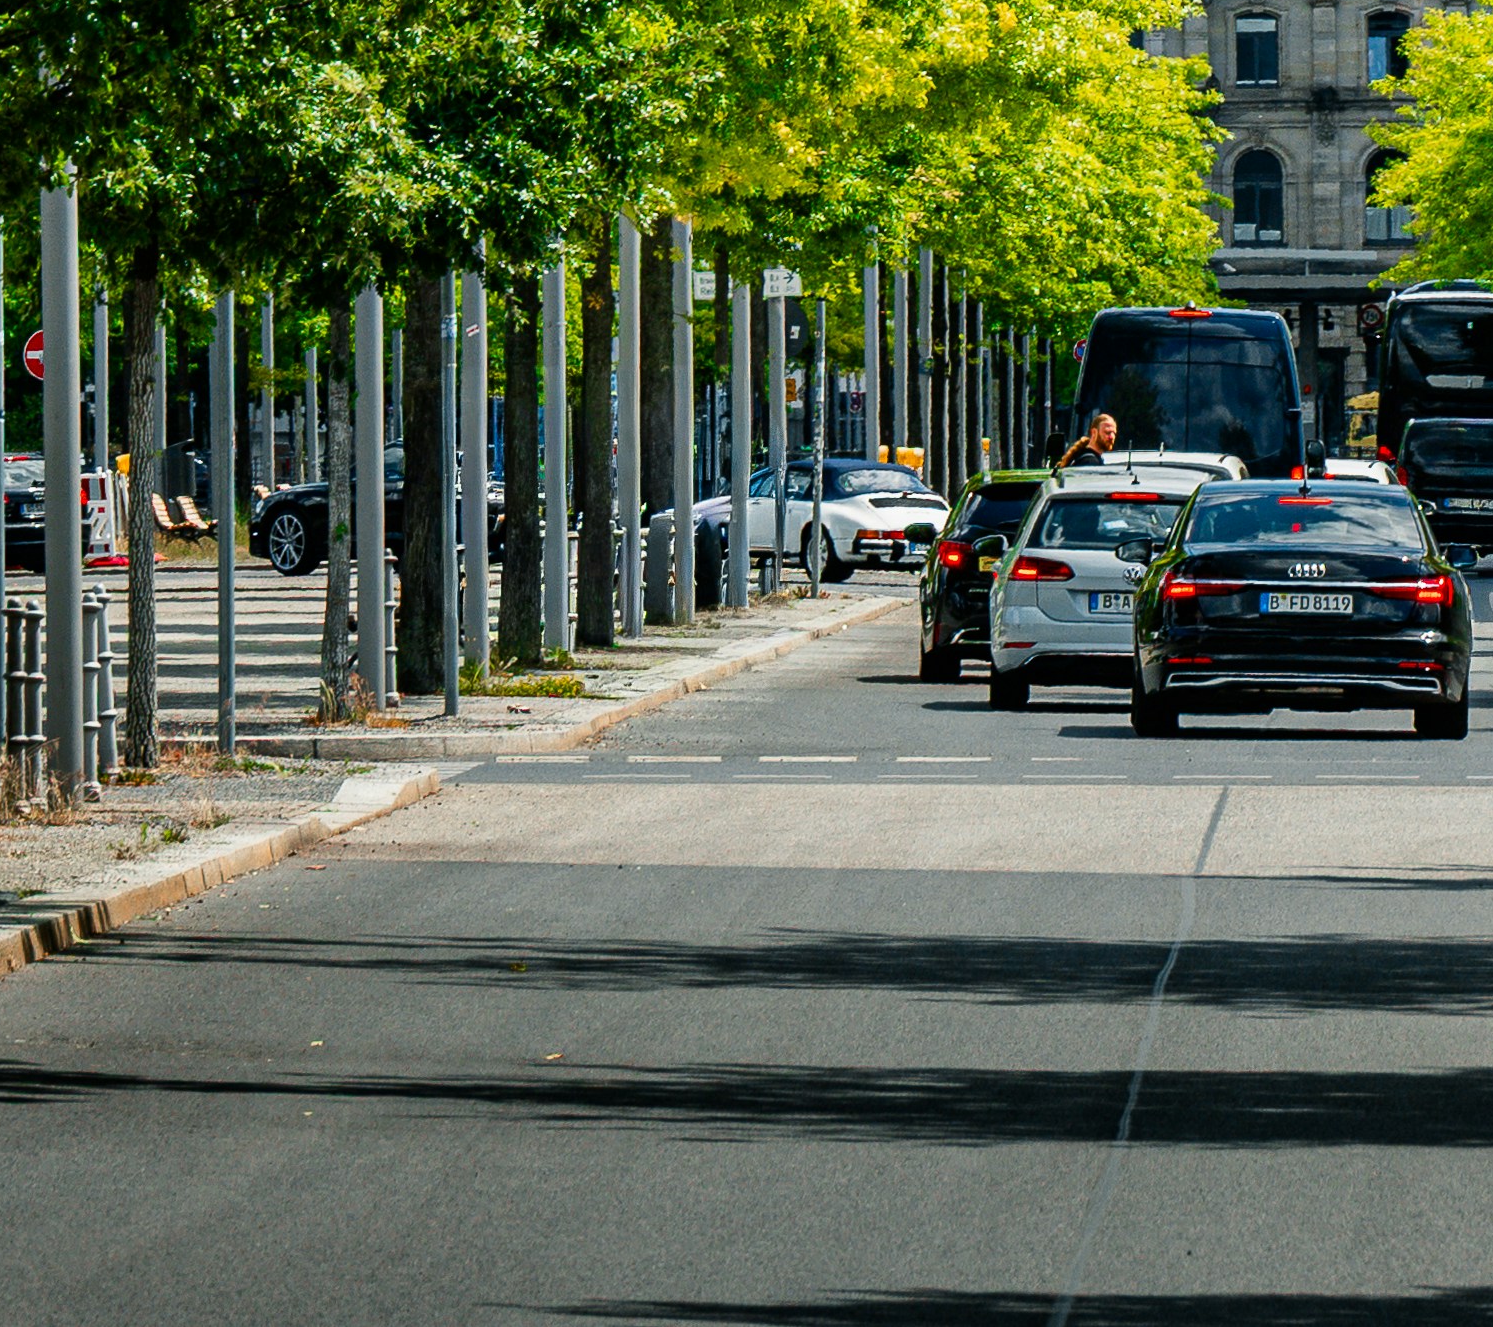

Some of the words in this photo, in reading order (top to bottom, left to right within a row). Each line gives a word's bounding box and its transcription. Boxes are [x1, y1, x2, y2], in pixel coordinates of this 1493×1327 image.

[1102, 594, 1113, 609] B
[1269, 594, 1281, 610] B
[1289, 595, 1310, 610] FD
[1313, 596, 1351, 611] 8119
